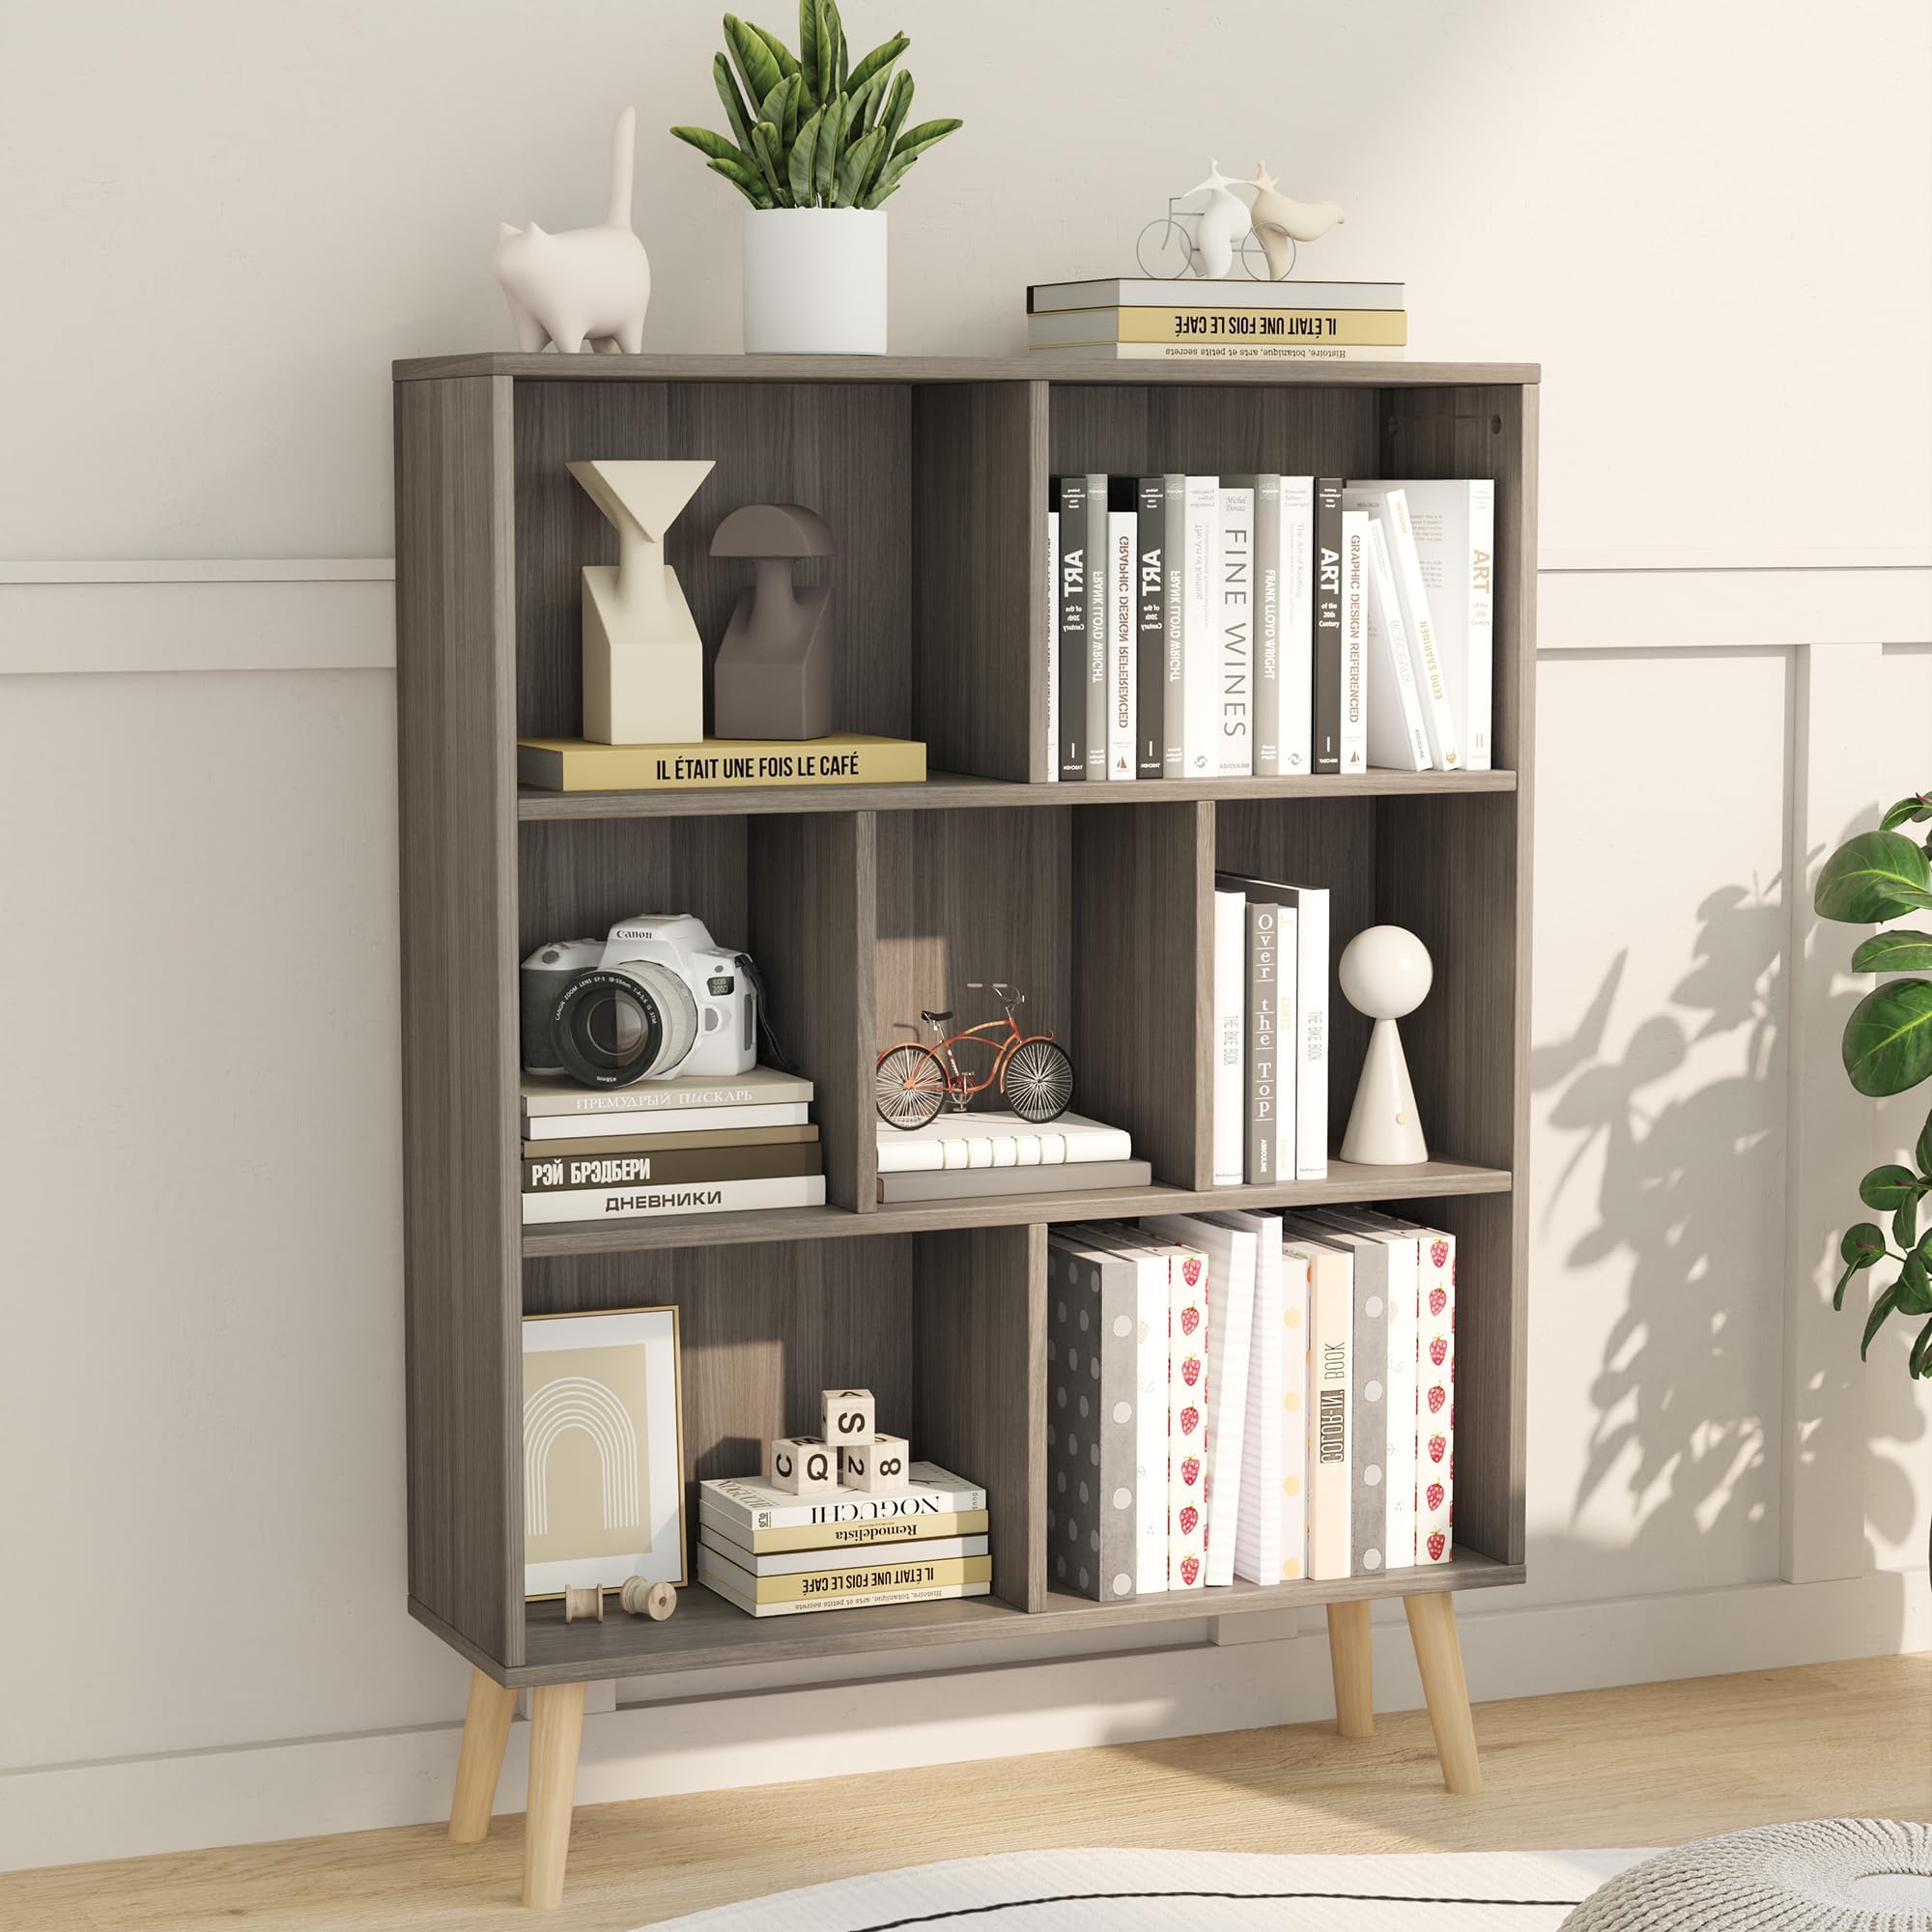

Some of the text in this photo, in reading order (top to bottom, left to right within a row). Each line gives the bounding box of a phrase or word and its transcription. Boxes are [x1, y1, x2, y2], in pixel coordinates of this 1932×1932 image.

[1174, 315, 1337, 338] IL ÉTAIT UNE FOIS LE CAFÉ
[1165, 348, 1199, 356] secrets
[1200, 347, 1227, 358] petits
[1239, 348, 1259, 356] arts
[1261, 347, 1306, 358] botanique,
[1307, 347, 1347, 358] Histoire,
[1320, 547, 1340, 595] ART
[1350, 534, 1361, 589] GRAPHIC
[1472, 549, 1490, 595] ART
[1264, 569, 1276, 680] FRANK LLOYD WRIGHT
[1319, 619, 1341, 629] Century
[1350, 593, 1361, 639] DESIGN
[1223, 528, 1247, 737] FINE WINES
[1350, 642, 1361, 724] REFERENCED
[656, 751, 860, 781] IL ÉTAIT UNE FOIS LE CAFÉ
[616, 928, 653, 940] Canon
[554, 1001, 565, 1021] CANON
[564, 985, 579, 1001] ZOOM
[579, 978, 592, 987] LENS
[1258, 913, 1274, 1119] Over the Top
[577, 1093, 671, 1111] ПРЕМУДРЫЙ
[531, 1157, 651, 1186] РЭЙ БРЭДБЕРИ
[605, 1190, 722, 1213] ДНЕВНИКИ
[838, 1411, 866, 1435] S
[776, 1453, 792, 1478] C
[807, 1453, 829, 1482] Q
[848, 1455, 865, 1476] 2
[879, 1457, 901, 1476] 8
[810, 1495, 940, 1524] NOGUCHI
[835, 1524, 918, 1542] Remodelista
[801, 1567, 934, 1596] IL ÉTAIT UNE FOIS LE CAFÉ
[855, 1597, 870, 1606] arts
